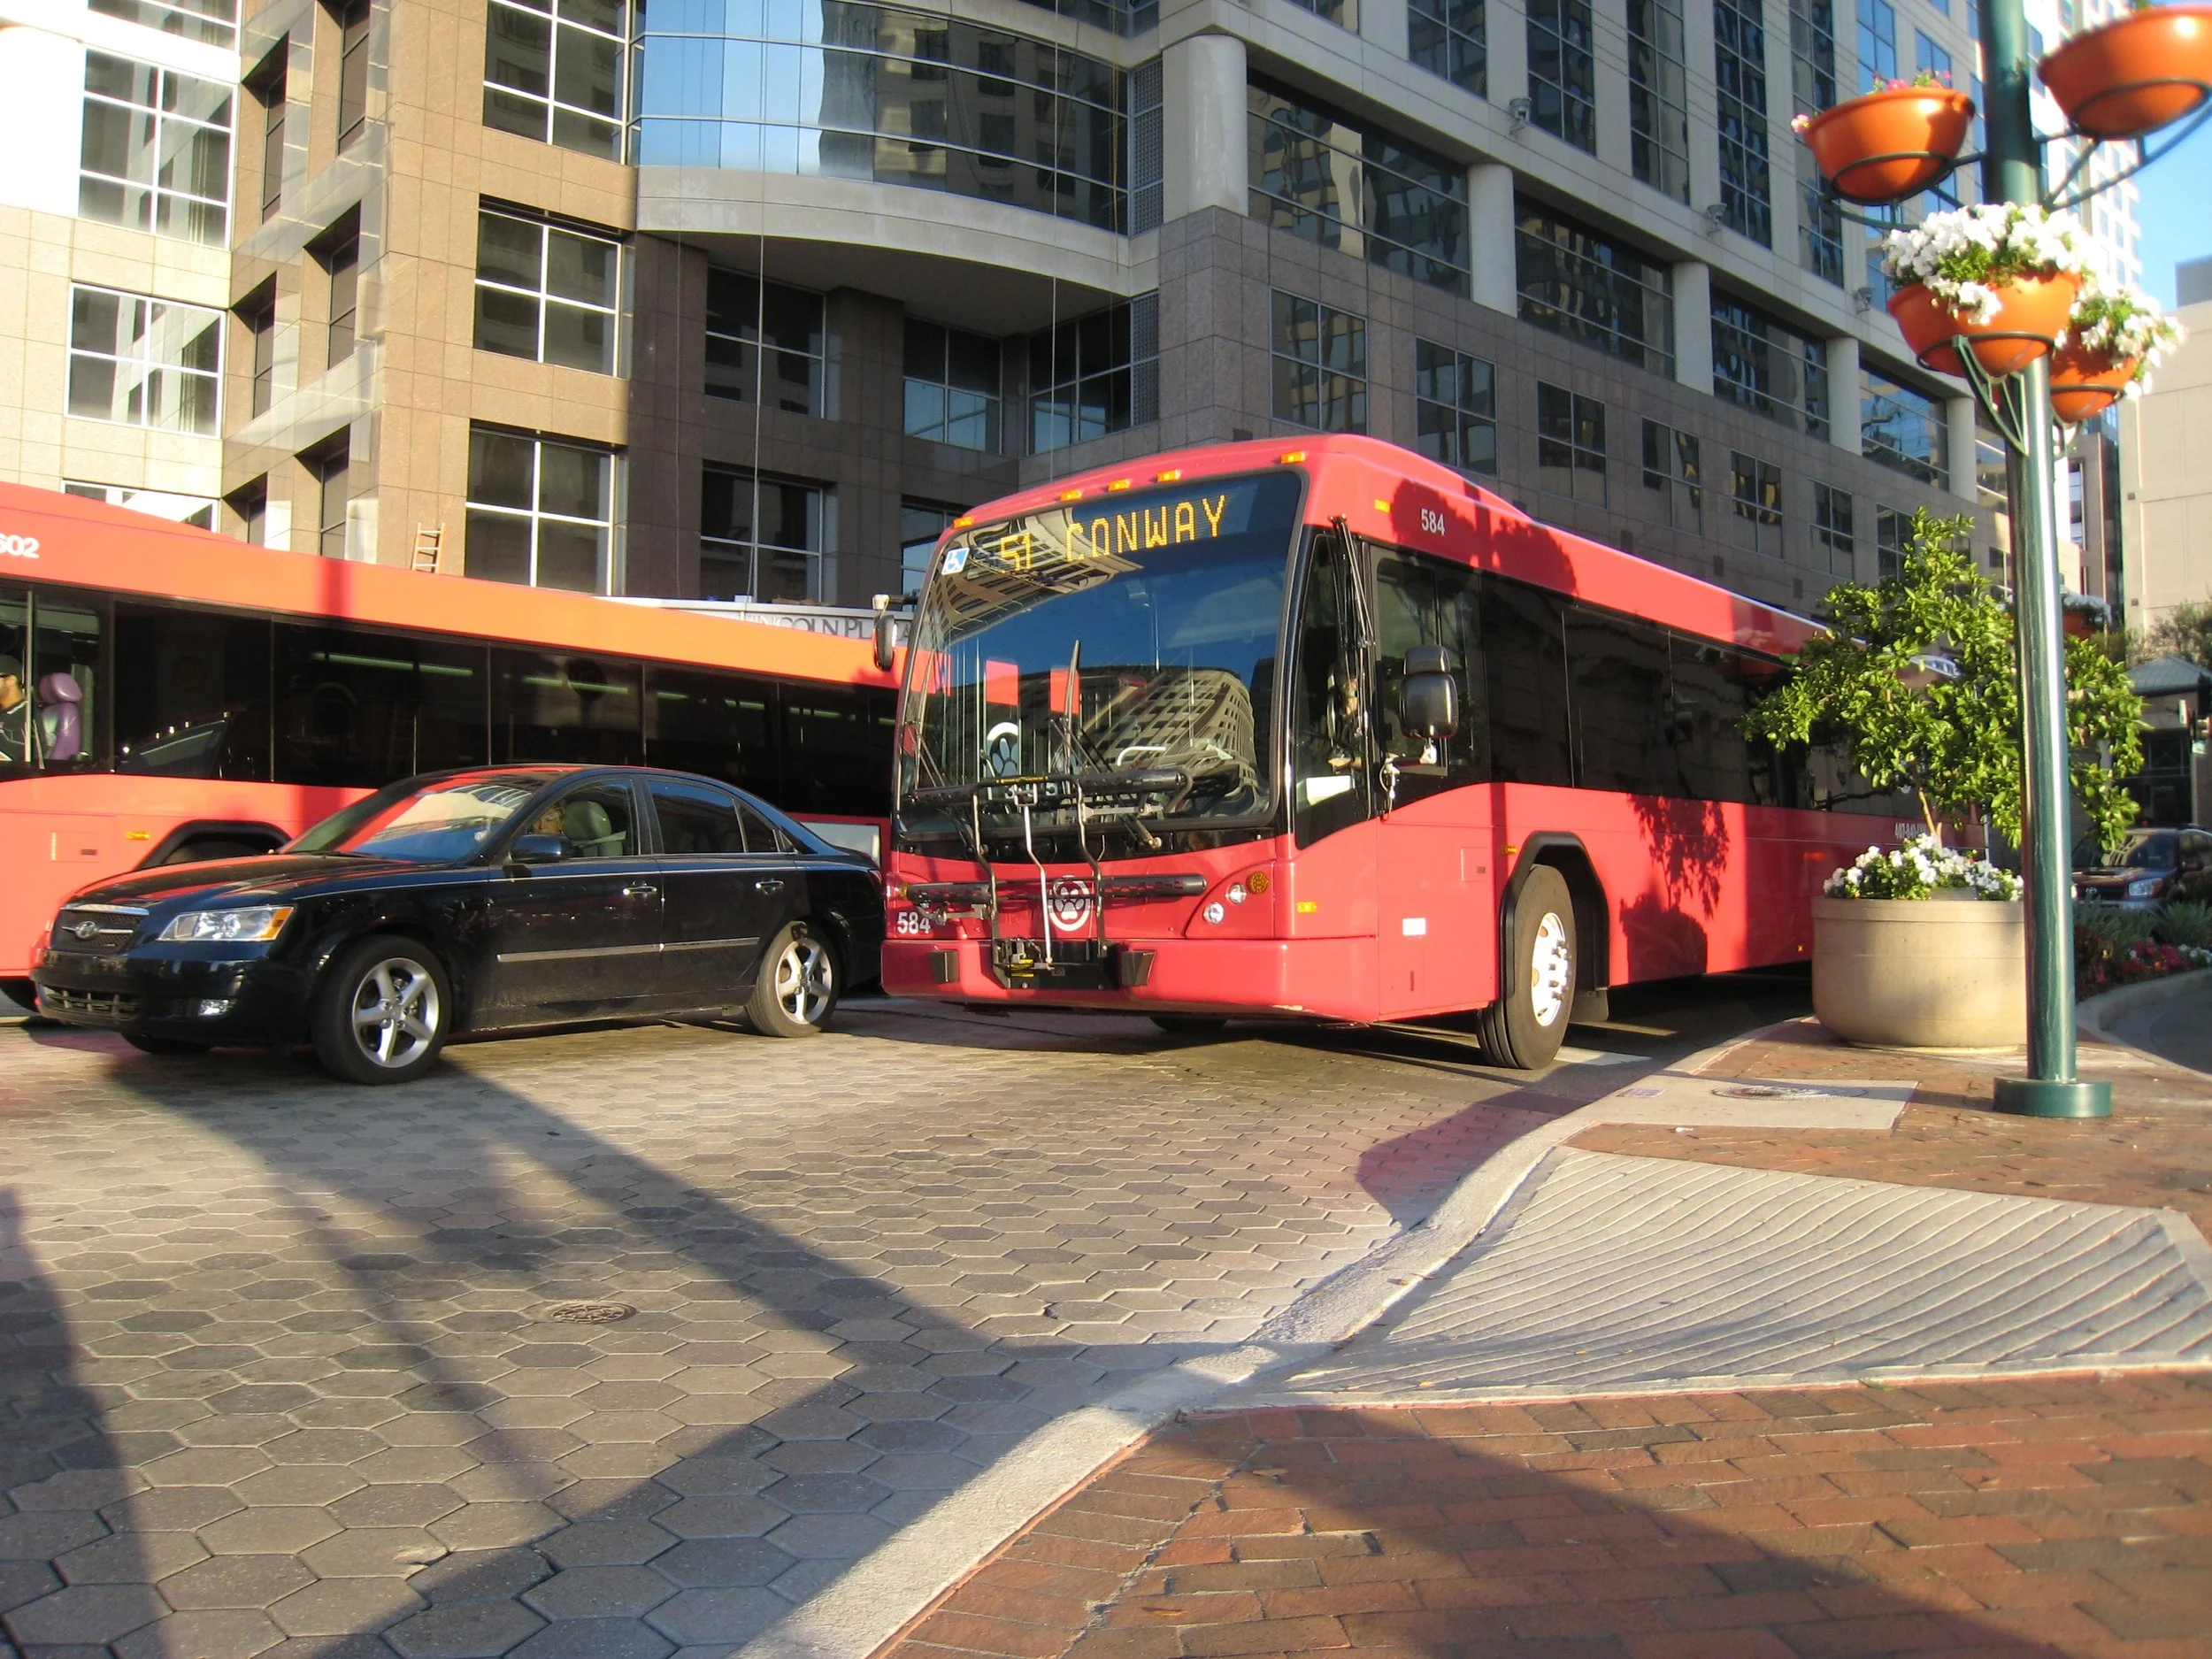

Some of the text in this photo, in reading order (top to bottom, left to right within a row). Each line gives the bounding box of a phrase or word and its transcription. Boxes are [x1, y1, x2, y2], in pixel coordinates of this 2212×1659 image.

[1066, 495, 1227, 562] CONWAY
[1421, 508, 1446, 536] 584
[751, 615, 839, 635] INCOLN
[897, 911, 931, 934] 584
